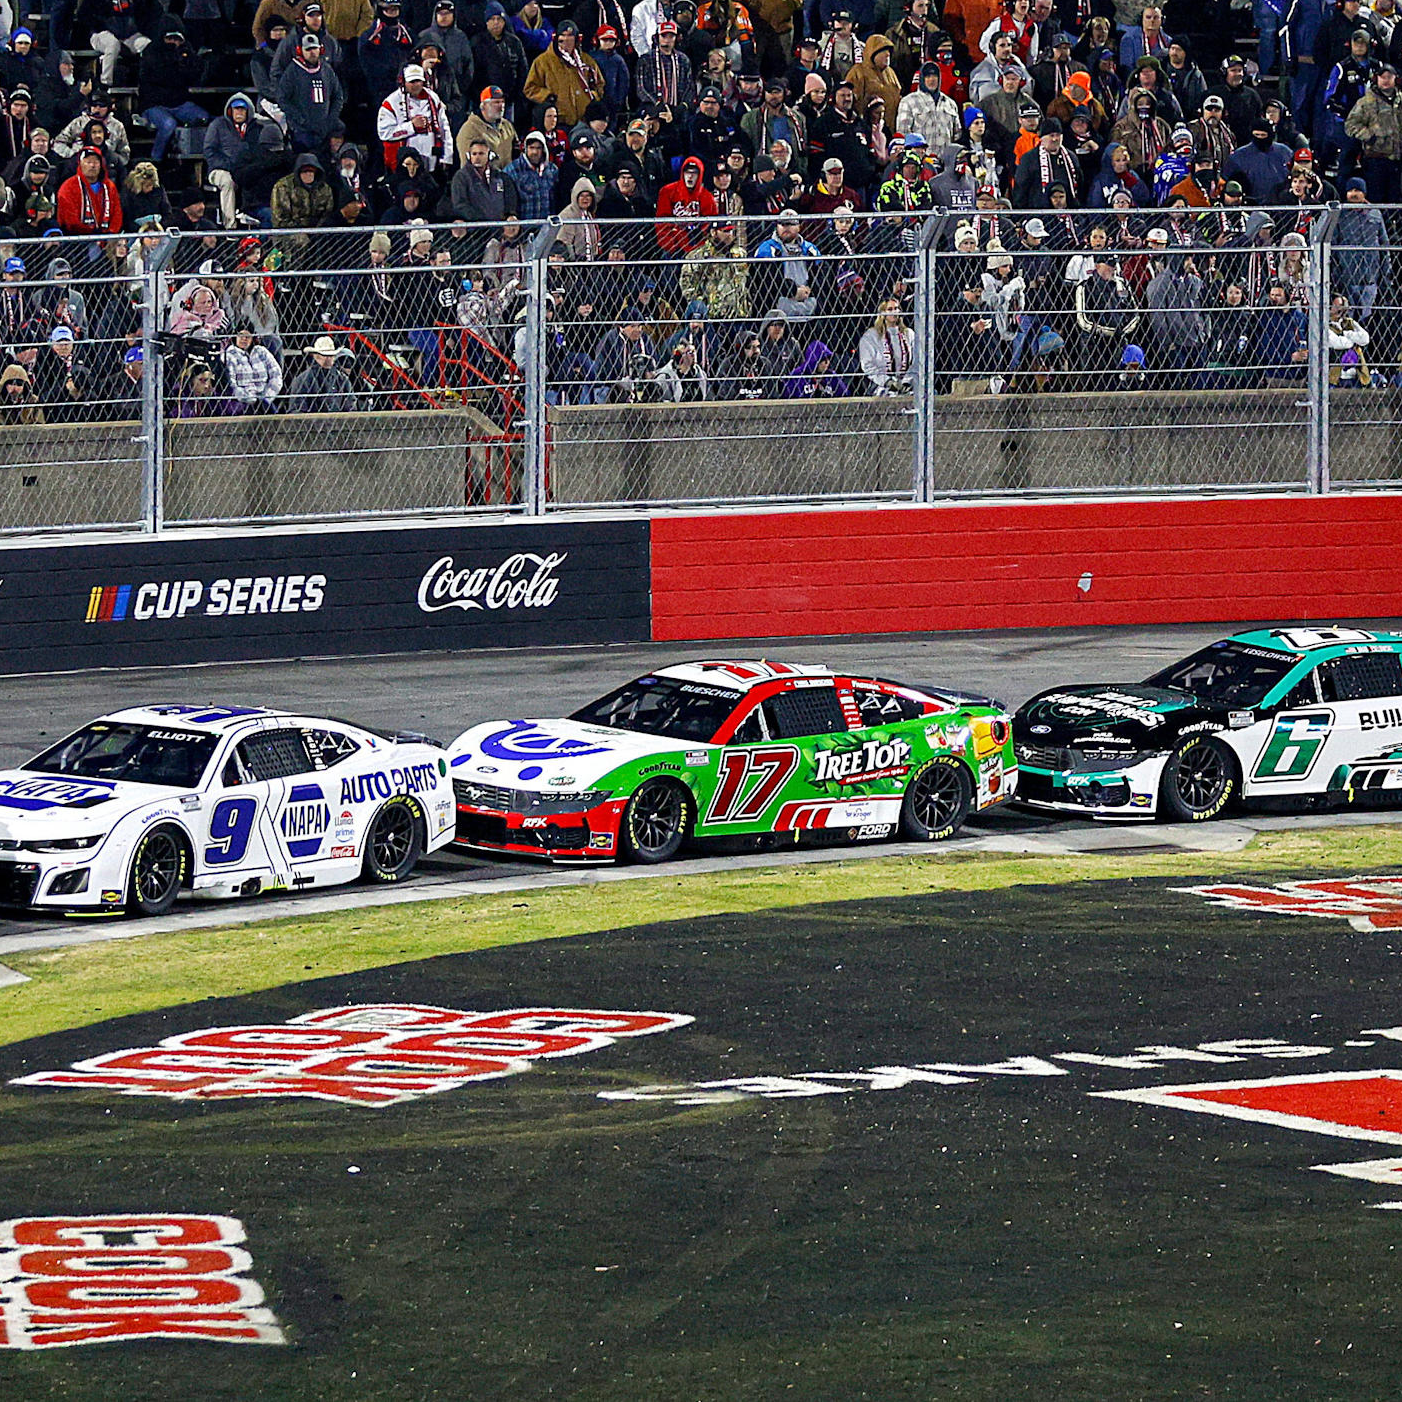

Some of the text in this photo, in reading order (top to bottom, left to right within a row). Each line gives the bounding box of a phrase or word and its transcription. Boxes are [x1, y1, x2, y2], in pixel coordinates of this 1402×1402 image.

[134, 574, 326, 620] CUP SERIES
[417, 551, 568, 612] Coca-Cola
[680, 684, 741, 699] BUESCHER
[147, 730, 206, 743] ELLIOTT
[1178, 720, 1225, 736] GOODYEAR
[1254, 714, 1330, 778] 6
[638, 761, 682, 776] GOODYEAR
[814, 738, 910, 781] TREE TOP
[340, 762, 437, 805] AUTO PARTS
[705, 746, 800, 826] 17
[204, 798, 258, 865] 9
[287, 804, 323, 837] NAPA
[859, 824, 891, 835] FORD
